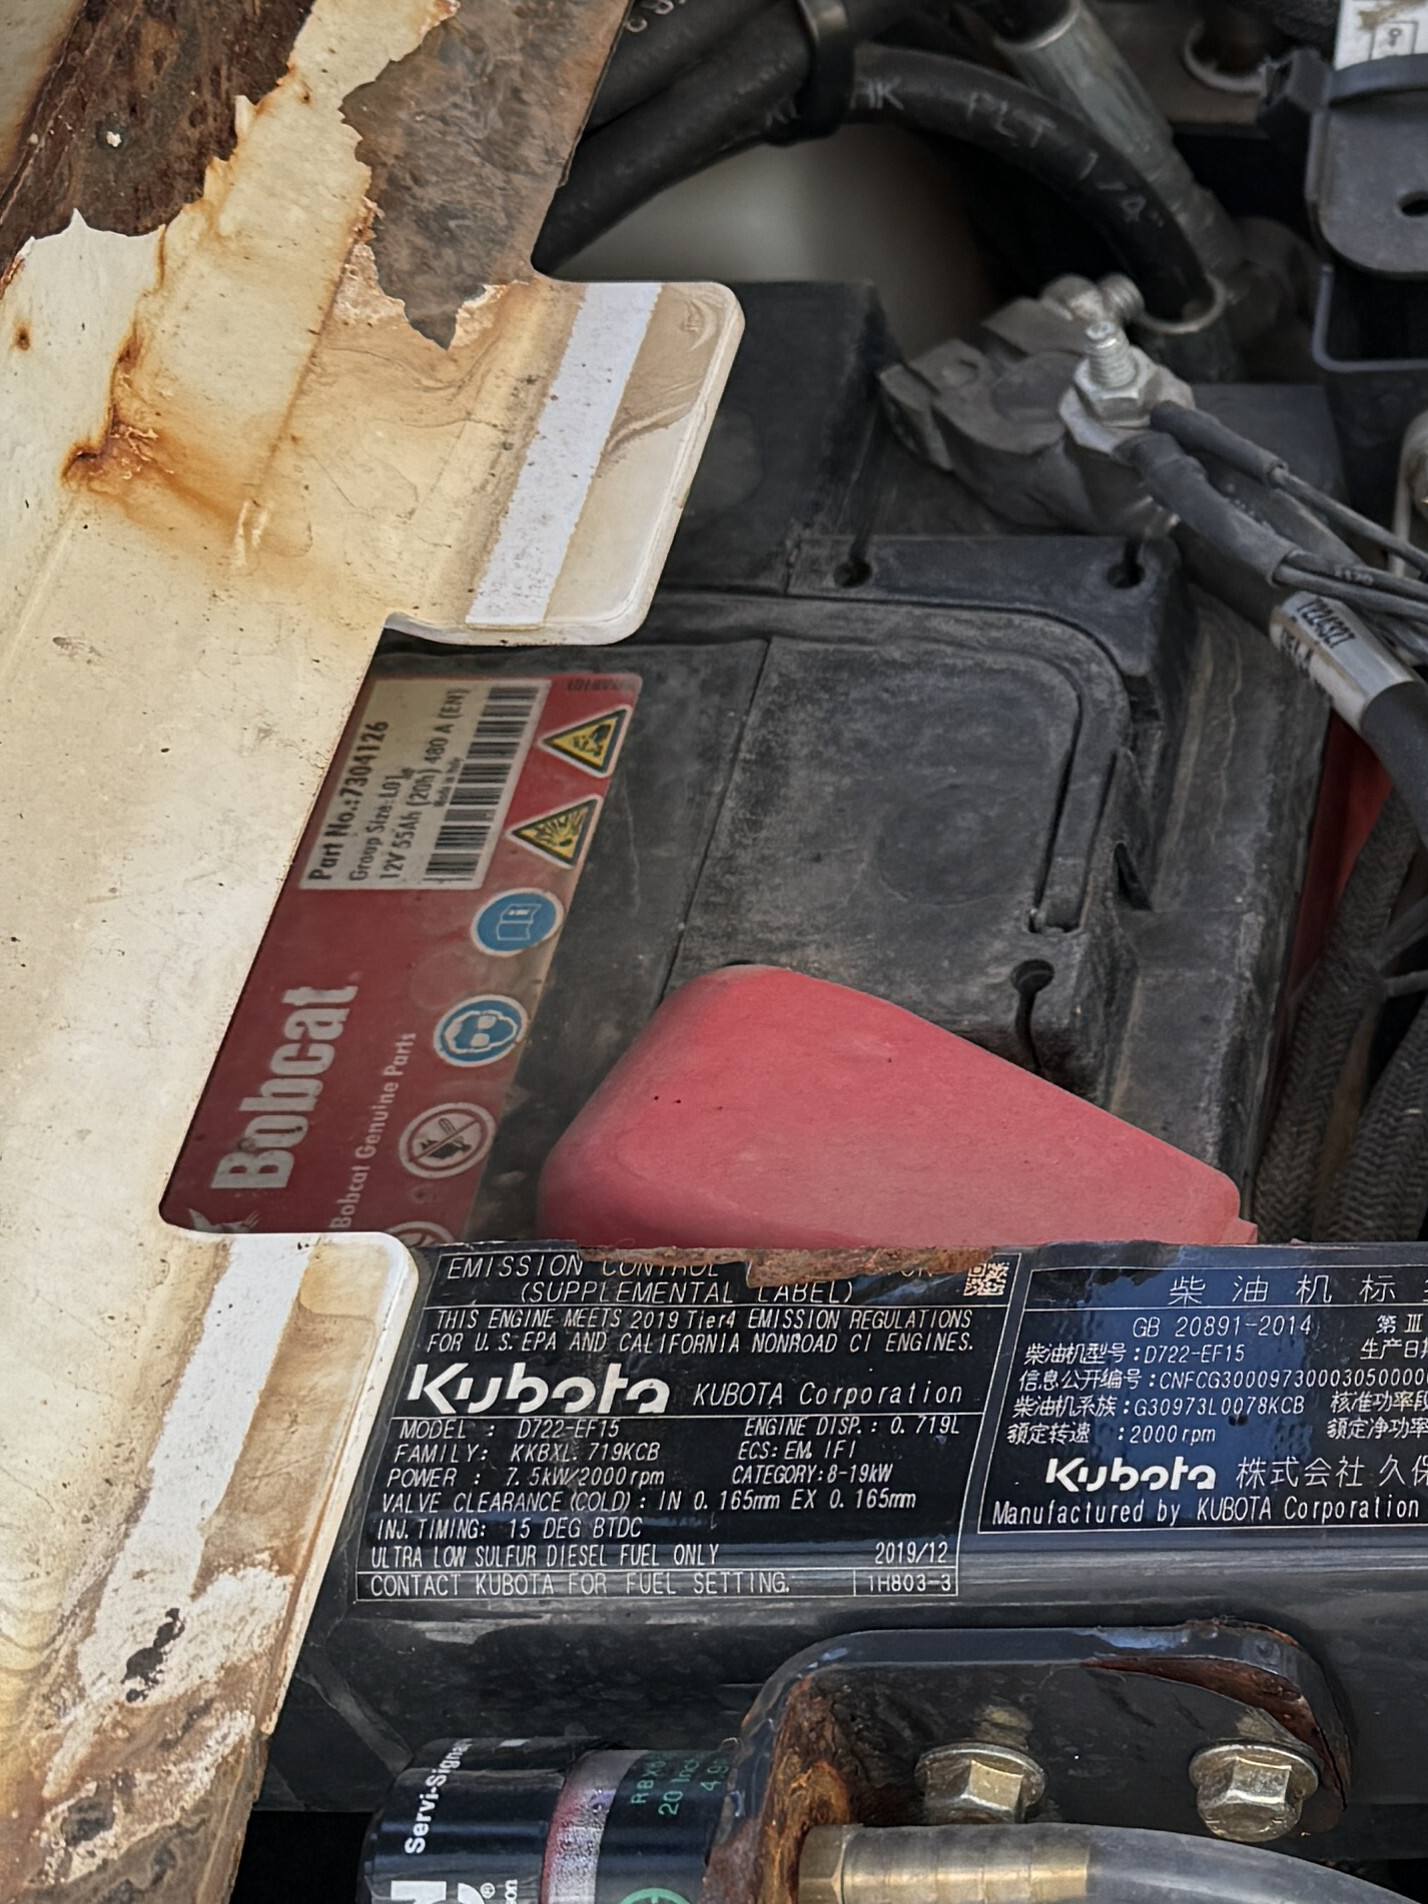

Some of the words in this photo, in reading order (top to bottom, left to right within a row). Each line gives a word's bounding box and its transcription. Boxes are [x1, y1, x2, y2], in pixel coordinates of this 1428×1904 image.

[308, 845, 344, 881] Part
[350, 837, 384, 882] Group
[380, 854, 406, 880] 12V
[210, 985, 359, 1190] Bobcat
[329, 1165, 371, 1229] Bobcat
[355, 1081, 399, 1159] Genuine
[384, 1032, 417, 1077] Parts
[445, 1255, 585, 1279] EMISSION
[517, 1281, 739, 1304] (SUPPLEMENTAL
[433, 1309, 480, 1331] THIS
[486, 1309, 555, 1330] ENGINE
[561, 1309, 624, 1330] MEETS
[628, 1308, 681, 1330] 2019
[683, 1308, 738, 1329] Tier4
[746, 1308, 841, 1329] EMISSION
[848, 1307, 974, 1329] REGULATIONS
[1130, 1315, 1162, 1339] GB
[1173, 1314, 1314, 1338] 20891-2014
[425, 1332, 465, 1354] FOR
[472, 1332, 517, 1354] U.S.
[519, 1332, 560, 1354] EPA
[568, 1332, 608, 1354] AND
[617, 1331, 743, 1353] CALIFORNIA
[750, 1331, 840, 1353] NONROAD
[847, 1331, 874, 1352] CI
[884, 1330, 977, 1352] ENGINES.
[401, 1360, 678, 1416] Kubota
[691, 1380, 787, 1408] KUBOTA
[797, 1379, 965, 1407] Corporation
[398, 1418, 471, 1441] MODEL
[515, 1417, 622, 1440] D722-EF15
[743, 1416, 809, 1438] ENGINE
[736, 1440, 780, 1461] ECS:
[385, 1466, 459, 1489] POWER
[1041, 1454, 1220, 1493] Kubota
[378, 1491, 444, 1514] VALVE
[450, 1490, 565, 1514] CLEARANCE
[657, 1489, 683, 1512] IN
[789, 1488, 819, 1511] EX
[989, 1497, 1146, 1528] Manufactured
[1152, 1497, 1182, 1527] by
[1194, 1495, 1274, 1523] KUBOTA
[1281, 1492, 1422, 1523] Corporation
[505, 1518, 534, 1541] 15
[540, 1517, 585, 1540] DEG
[590, 1517, 645, 1540] BTDC
[368, 1545, 431, 1569] ULTRA
[432, 1545, 469, 1569] LOW
[473, 1544, 540, 1569] SULFUR
[545, 1543, 612, 1568] DIESEL
[616, 1543, 665, 1567] FUEL
[670, 1543, 721, 1567] ONLY
[872, 1540, 951, 1564] 2019/12
[366, 1573, 464, 1598] CONTACT
[471, 1572, 557, 1597] KUBOTA
[564, 1572, 609, 1596] FOR
[622, 1571, 679, 1596] FUEL
[690, 1571, 794, 1595] SETTING.
[866, 1572, 954, 1593] 1H803-3
